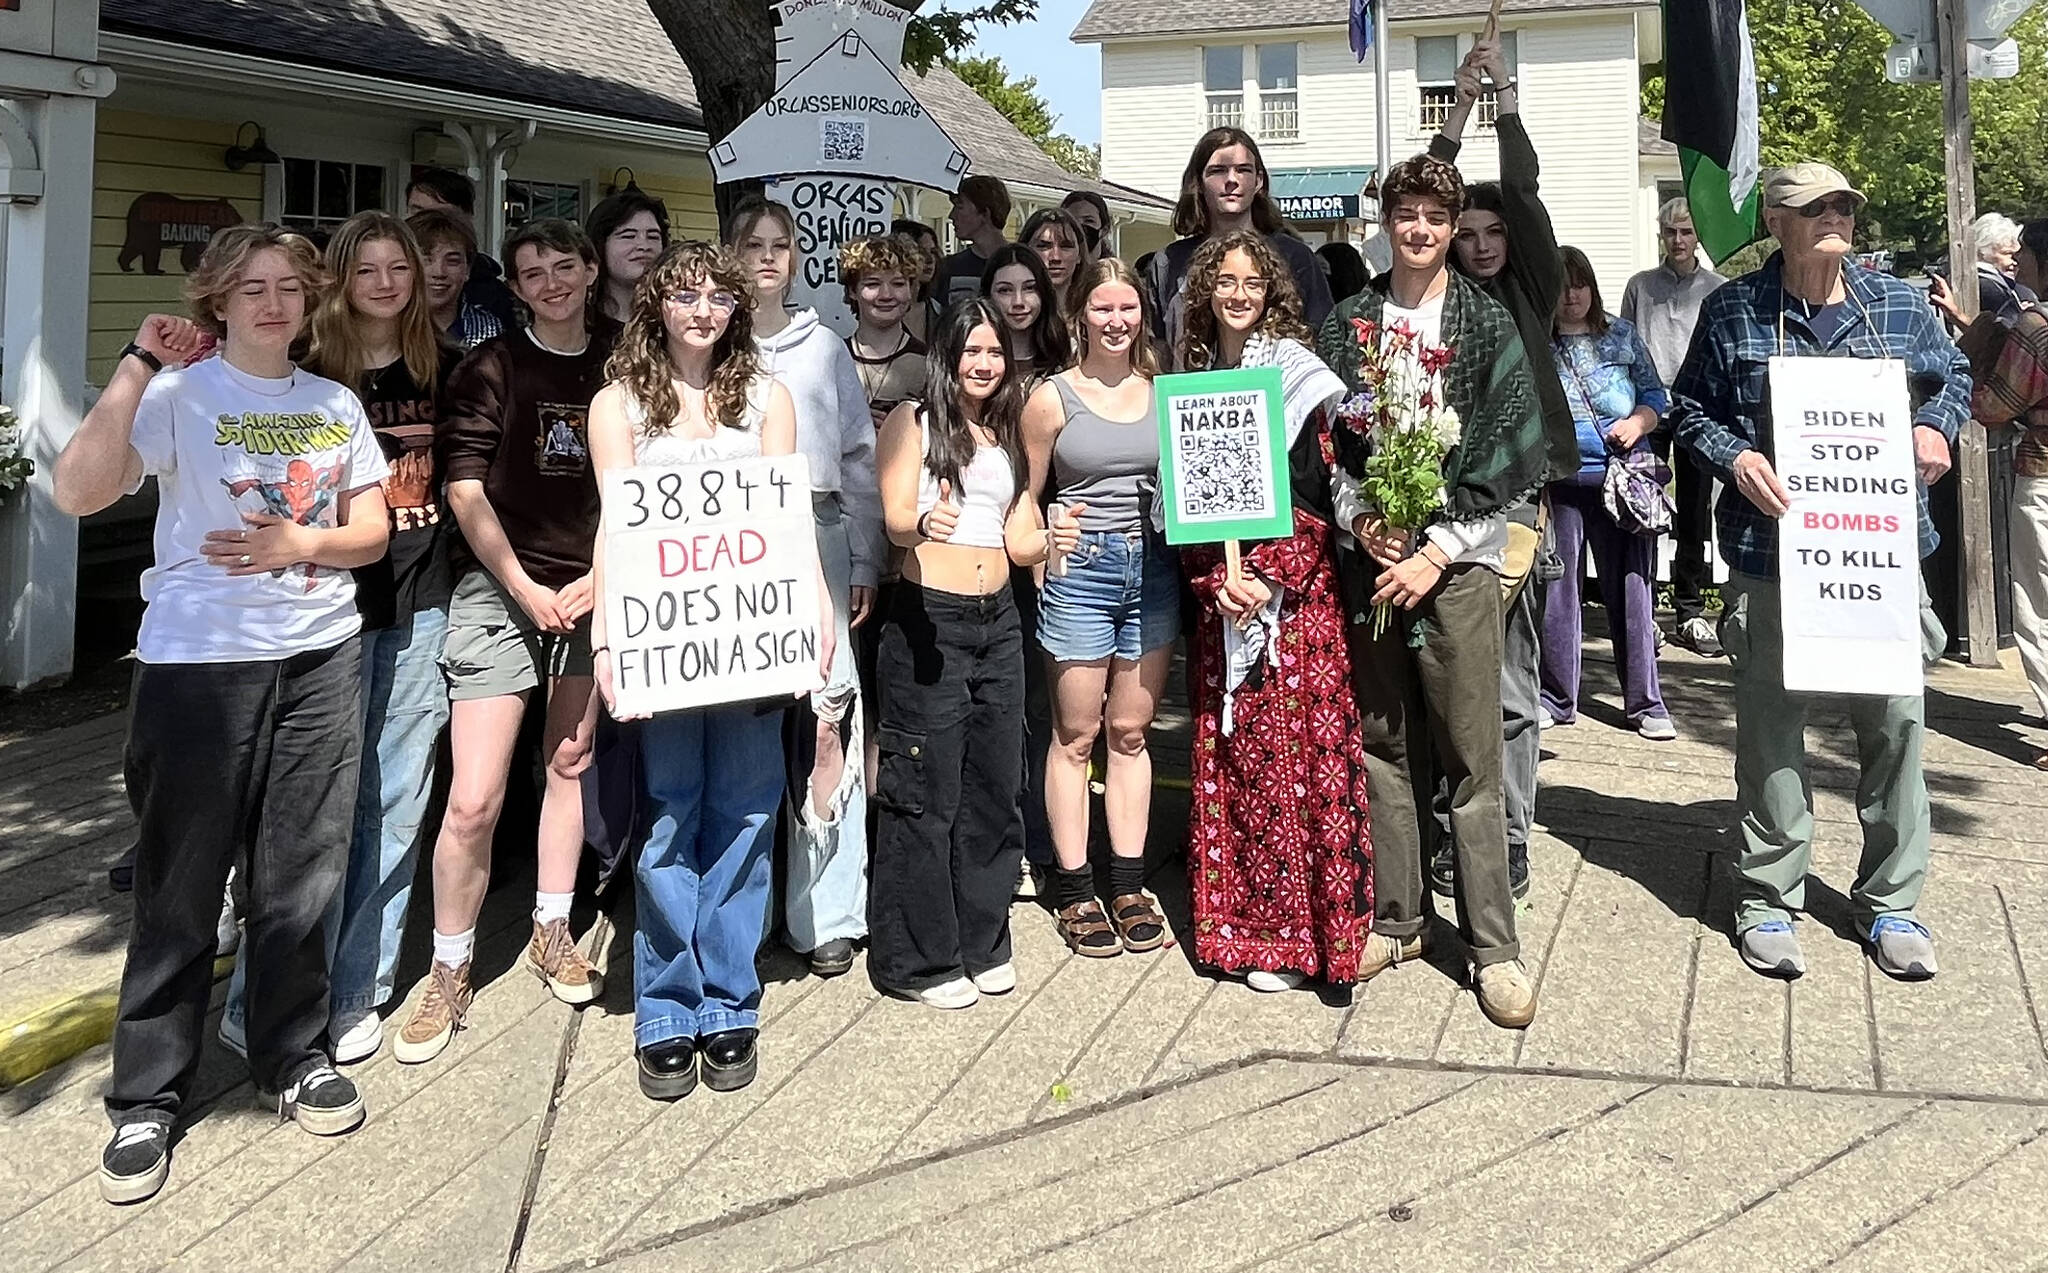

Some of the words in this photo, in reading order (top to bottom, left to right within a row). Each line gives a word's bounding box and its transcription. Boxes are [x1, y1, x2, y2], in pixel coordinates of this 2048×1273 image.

[765, 95, 921, 119] ORCASSENIORS.ORG
[791, 180, 887, 214] ORCAS
[1280, 197, 1344, 212] HARBOR
[1290, 209, 1345, 219] CHARTERS
[160, 223, 211, 242] BAKING
[1176, 397, 1215, 410] LEARN
[1220, 394, 1259, 406] ABOUT
[241, 410, 327, 430] AMAZING
[1180, 408, 1257, 432] NAKBA
[1804, 410, 1886, 429] BIDEN
[1811, 444, 1880, 462] STOP
[1787, 475, 1909, 496] SENDING
[623, 467, 792, 527] 38,844
[1803, 512, 1900, 533] BOMBS
[658, 529, 767, 577] DEAD
[1797, 549, 1832, 566] TO
[1842, 550, 1902, 569] KILL
[1819, 582, 1883, 601] KIDS
[623, 584, 721, 638] DOES
[736, 579, 798, 622] NOT
[620, 645, 676, 690] FIT
[680, 637, 719, 682] ON
[728, 634, 747, 675] A
[755, 626, 816, 671] SIGN
